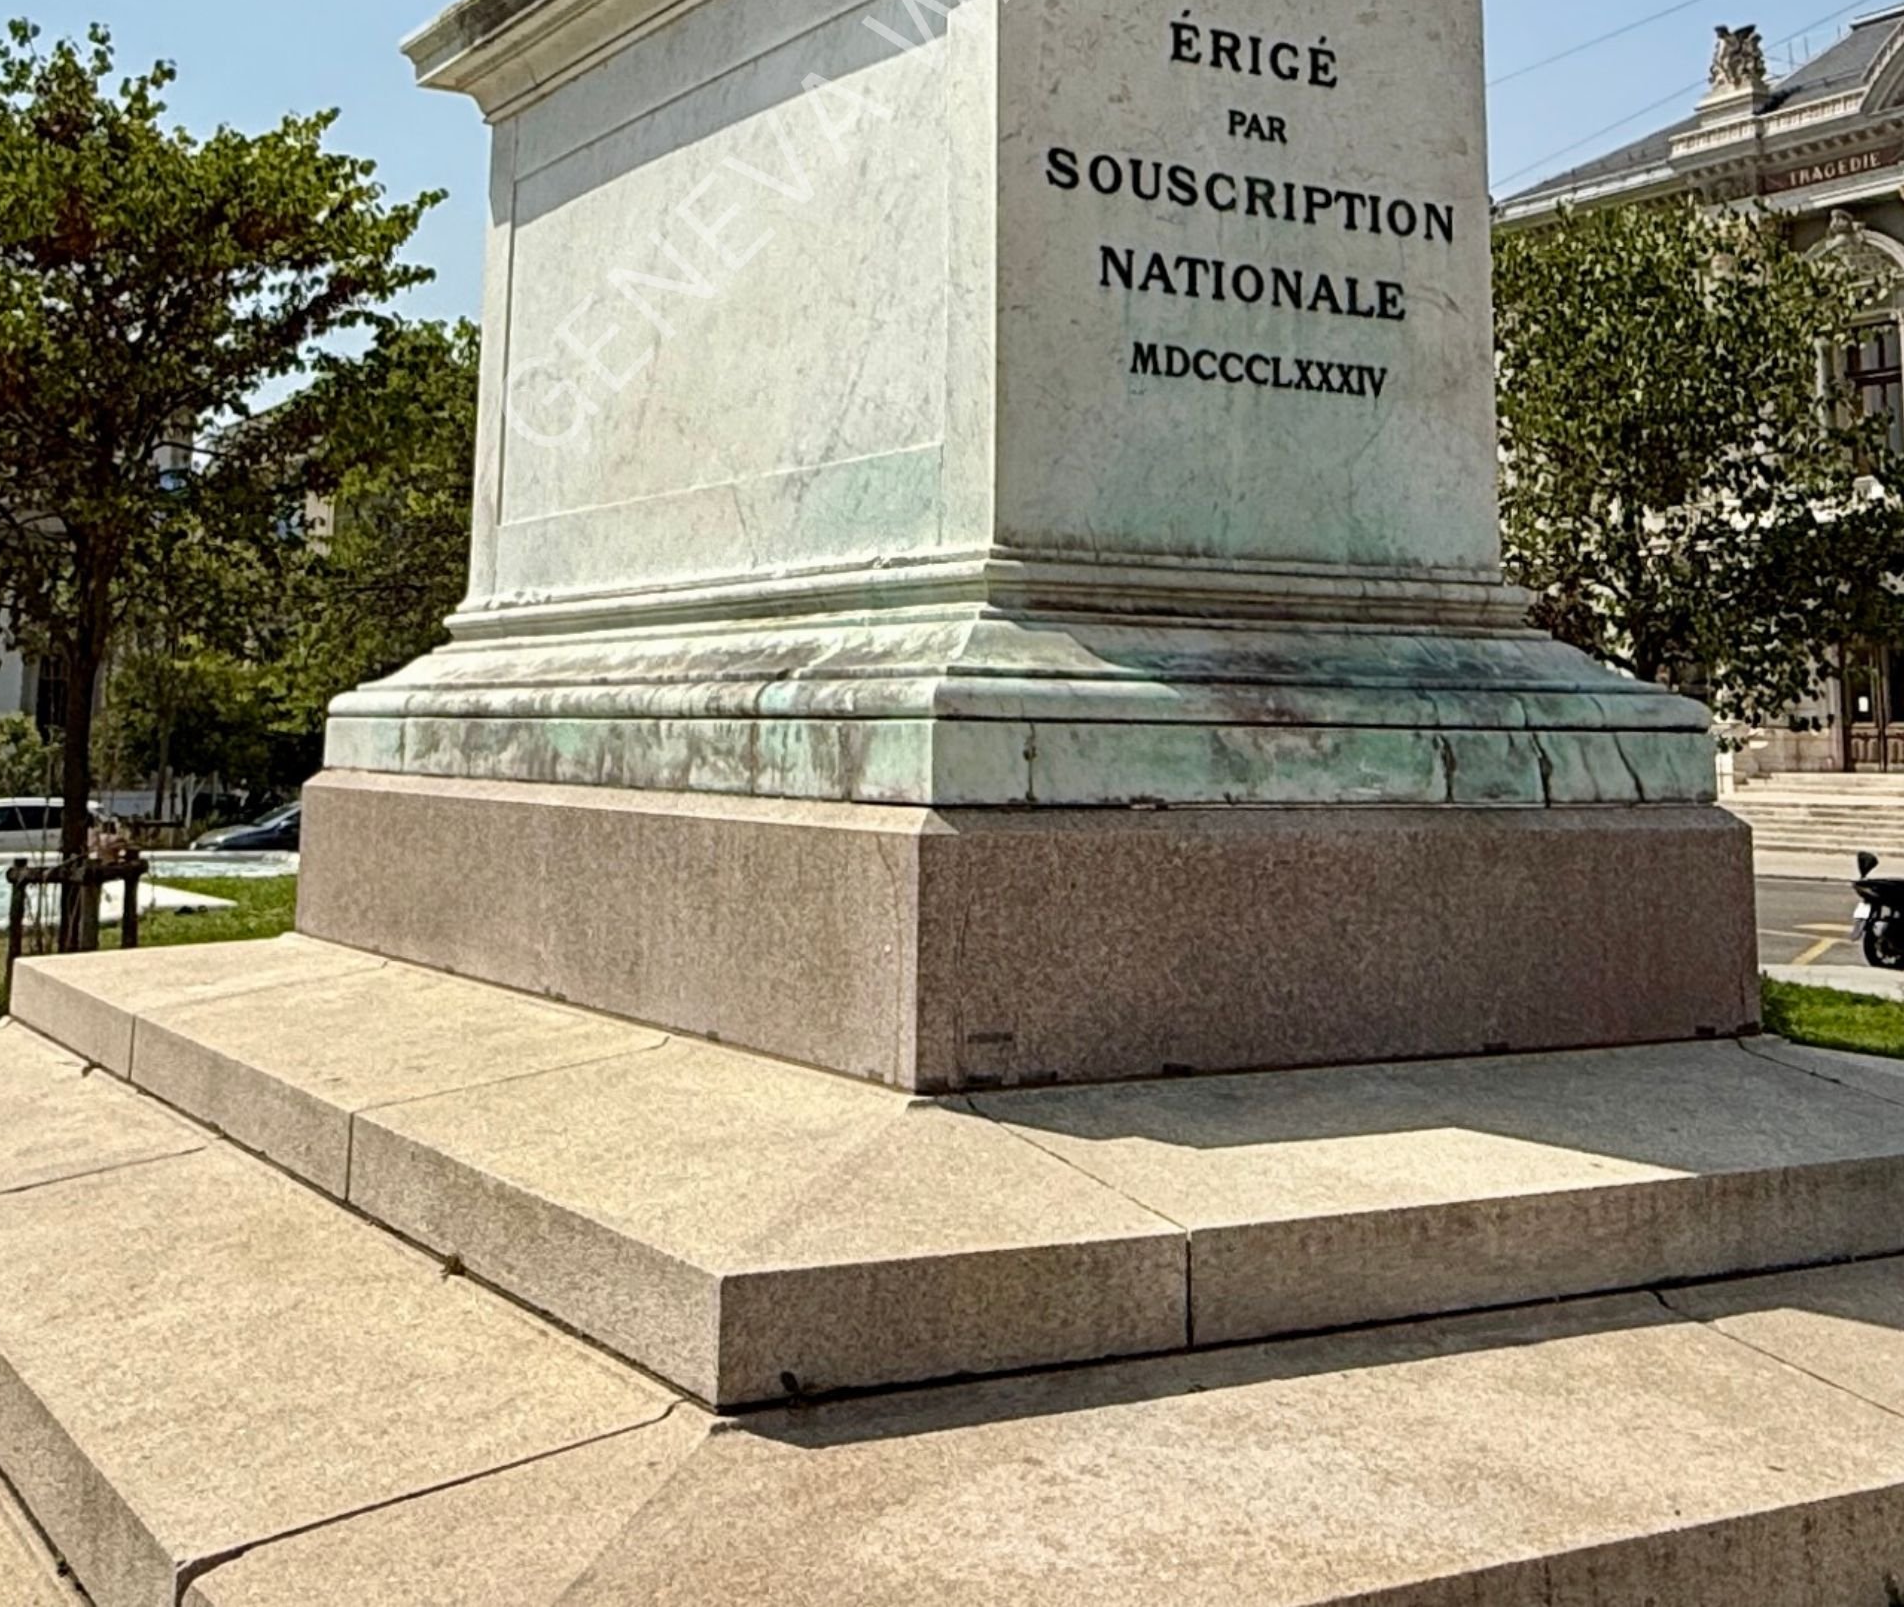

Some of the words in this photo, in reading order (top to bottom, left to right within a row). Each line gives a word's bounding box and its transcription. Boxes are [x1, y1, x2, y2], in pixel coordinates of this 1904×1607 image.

[1169, 9, 1338, 89] ÉRIGÉ
[1227, 109, 1288, 145] PAR
[1045, 147, 1455, 245] SOUSCRIPTION
[1789, 151, 1881, 187] TRAGEDIE
[1099, 246, 1406, 322] NATIONALE
[1130, 342, 1388, 400] MDCCCLXXXIV
